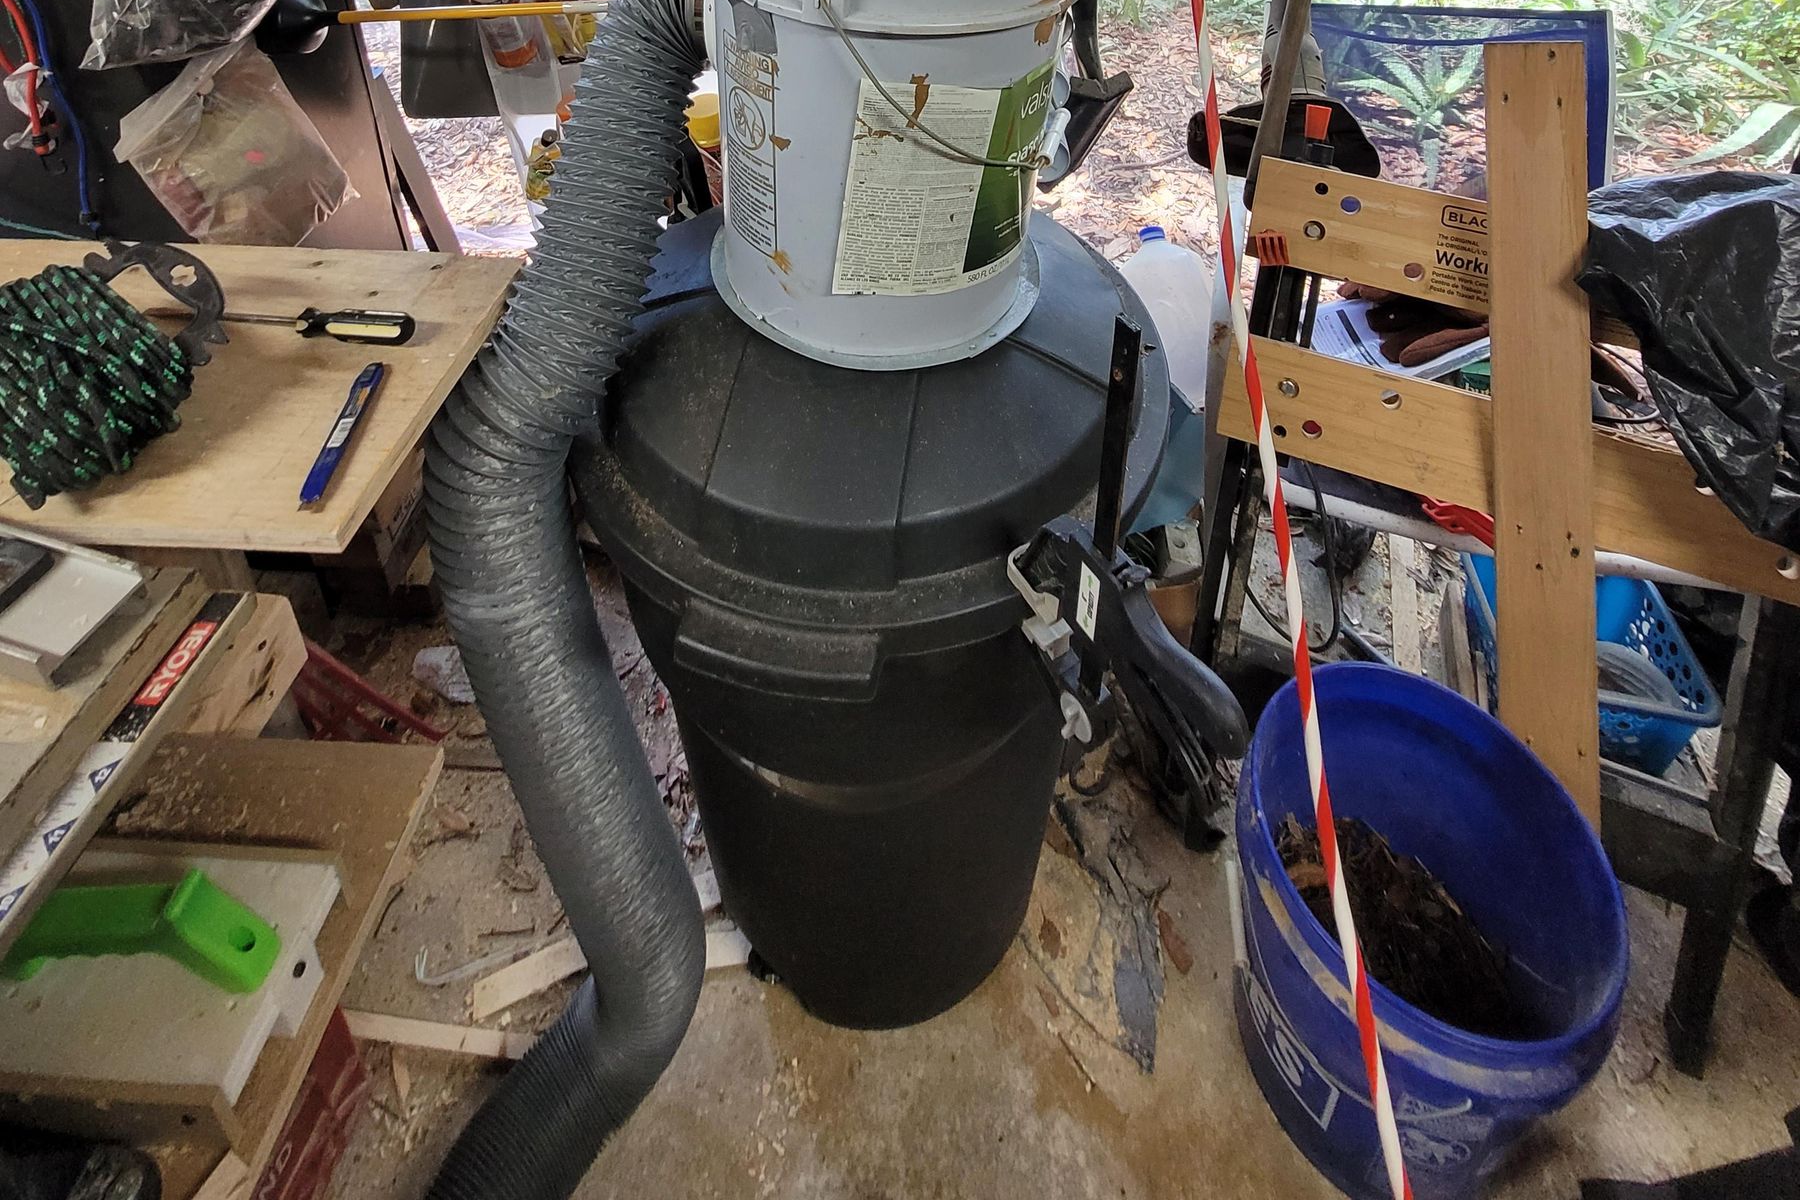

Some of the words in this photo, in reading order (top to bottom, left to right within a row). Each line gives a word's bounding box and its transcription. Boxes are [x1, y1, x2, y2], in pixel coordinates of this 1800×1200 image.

[1438, 233, 1449, 241] The
[1450, 236, 1480, 247] ORIGINAL
[1431, 271, 1456, 281] Portable
[1430, 278, 1451, 288] Centro
[140, 627, 210, 700] RYOBI
